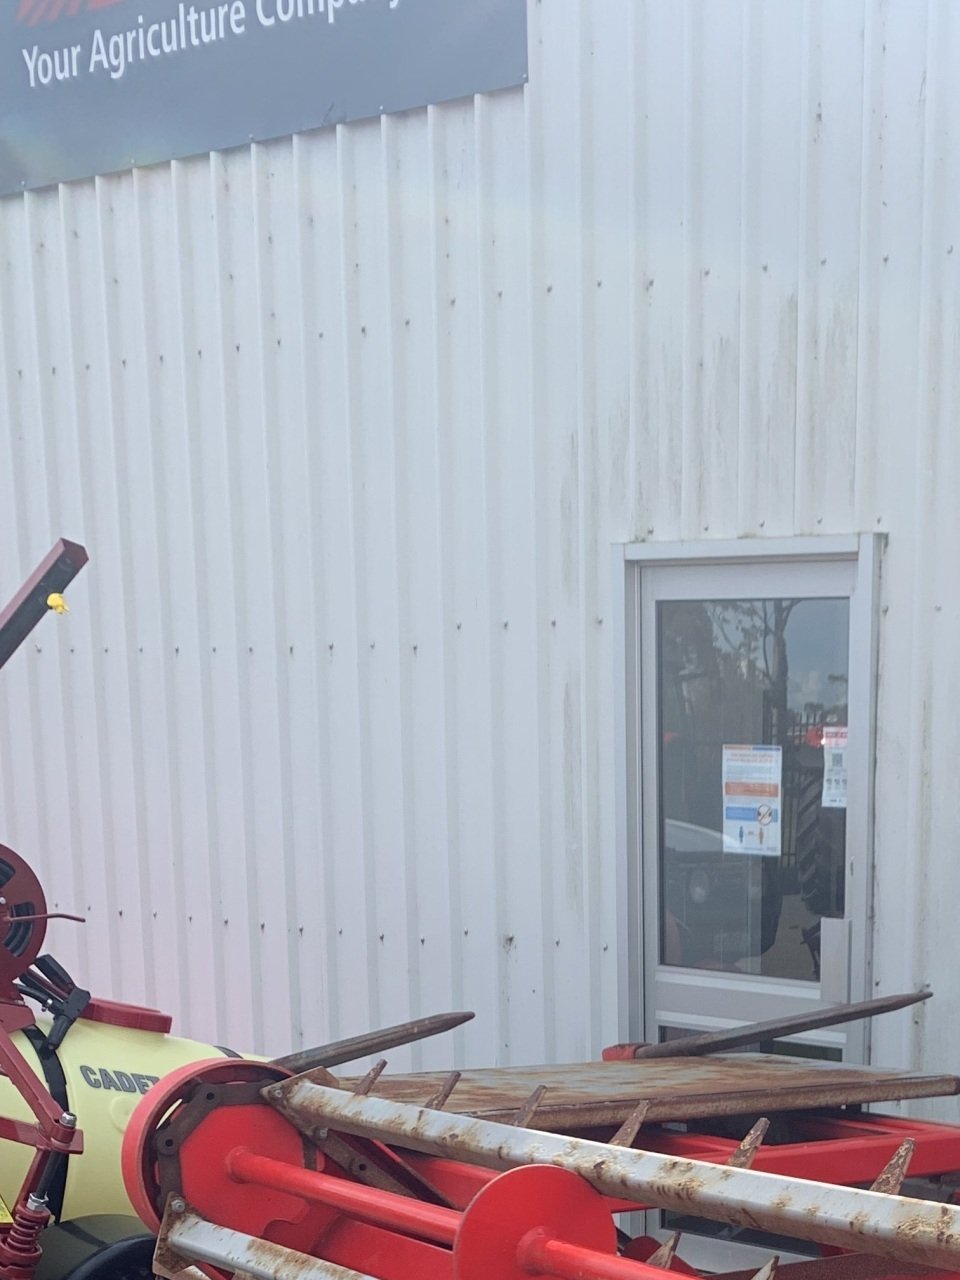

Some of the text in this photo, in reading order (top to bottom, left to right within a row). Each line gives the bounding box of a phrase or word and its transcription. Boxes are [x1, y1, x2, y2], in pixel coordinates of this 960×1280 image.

[22, 45, 81, 87] Your
[89, 2, 245, 79] Agriculture
[256, 0, 399, 26] Comp
